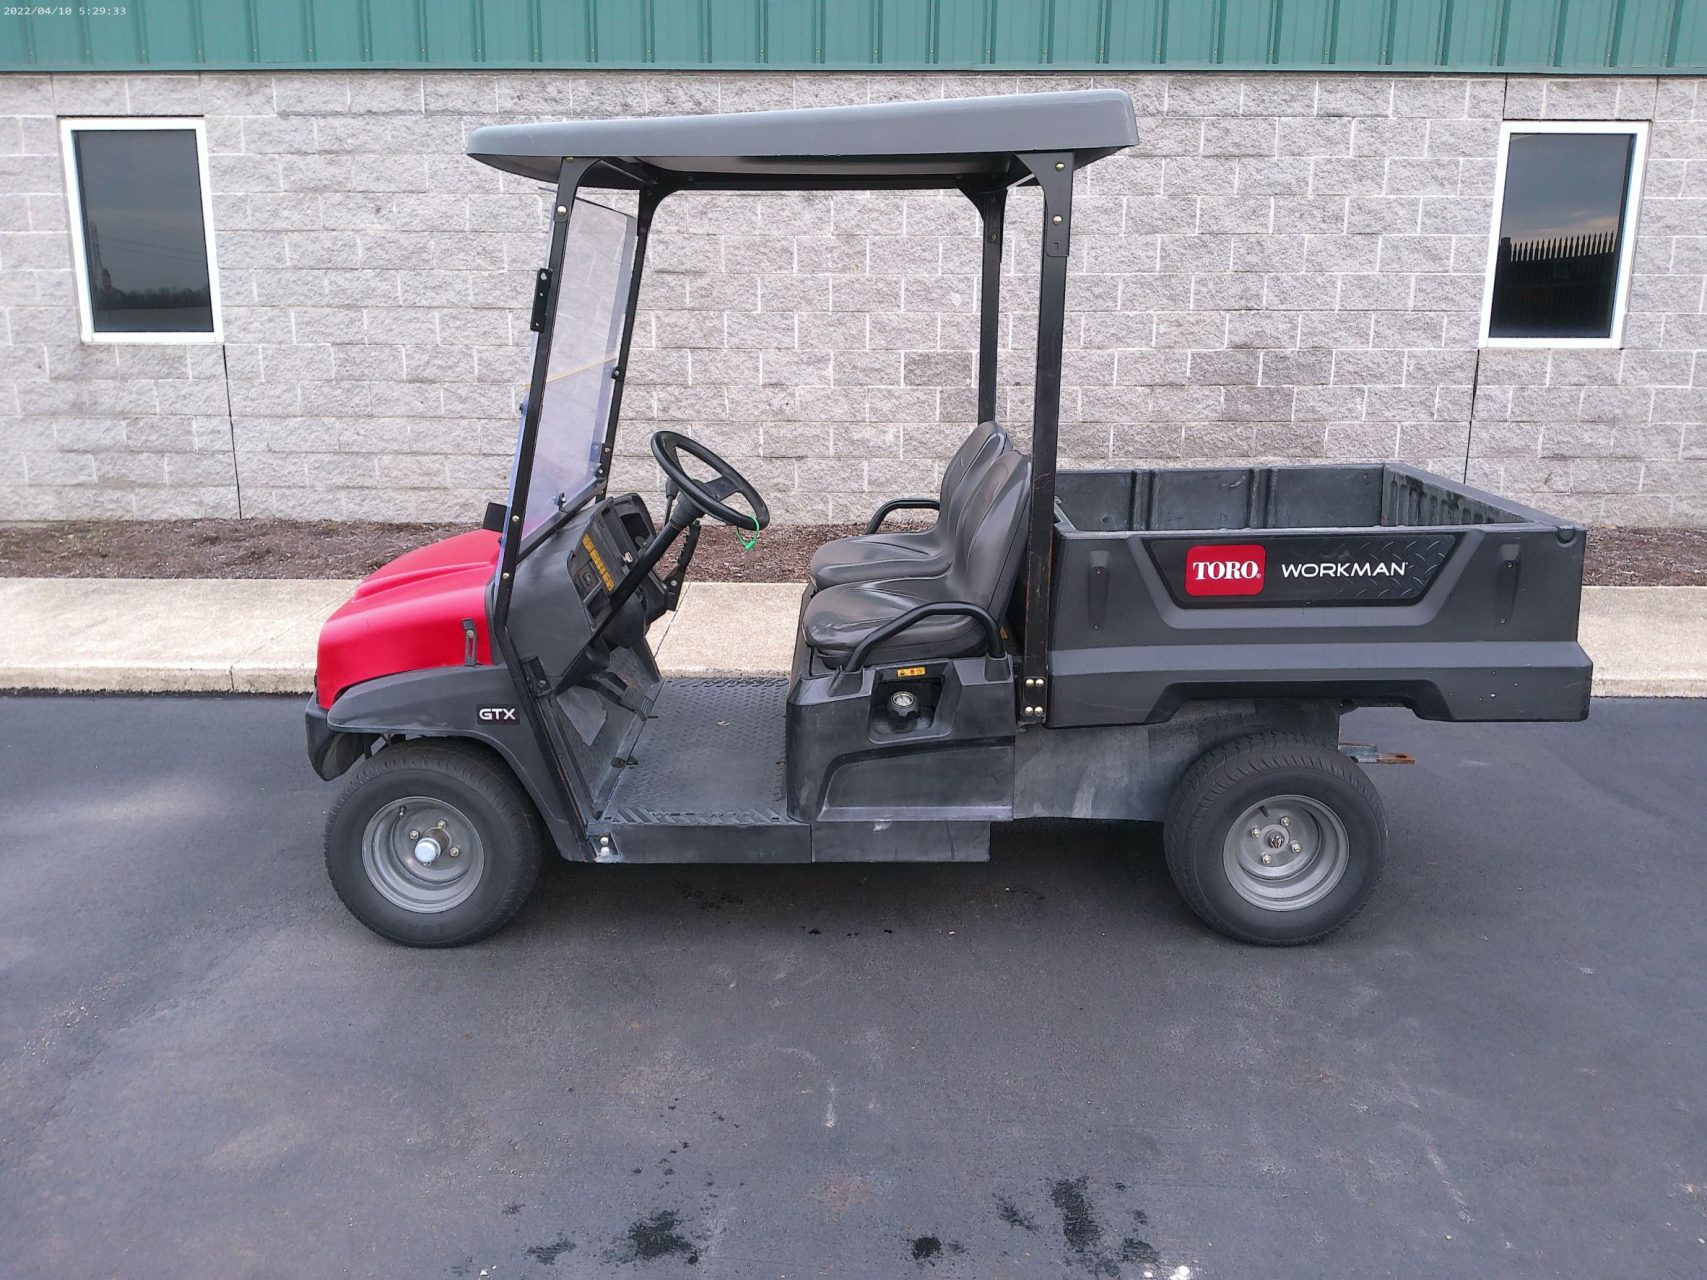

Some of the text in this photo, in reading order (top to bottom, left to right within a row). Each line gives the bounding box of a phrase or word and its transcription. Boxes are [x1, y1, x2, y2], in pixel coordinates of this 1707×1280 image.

[1192, 560, 1407, 580] TORO WORKMAN
[478, 708, 516, 720] GTX
